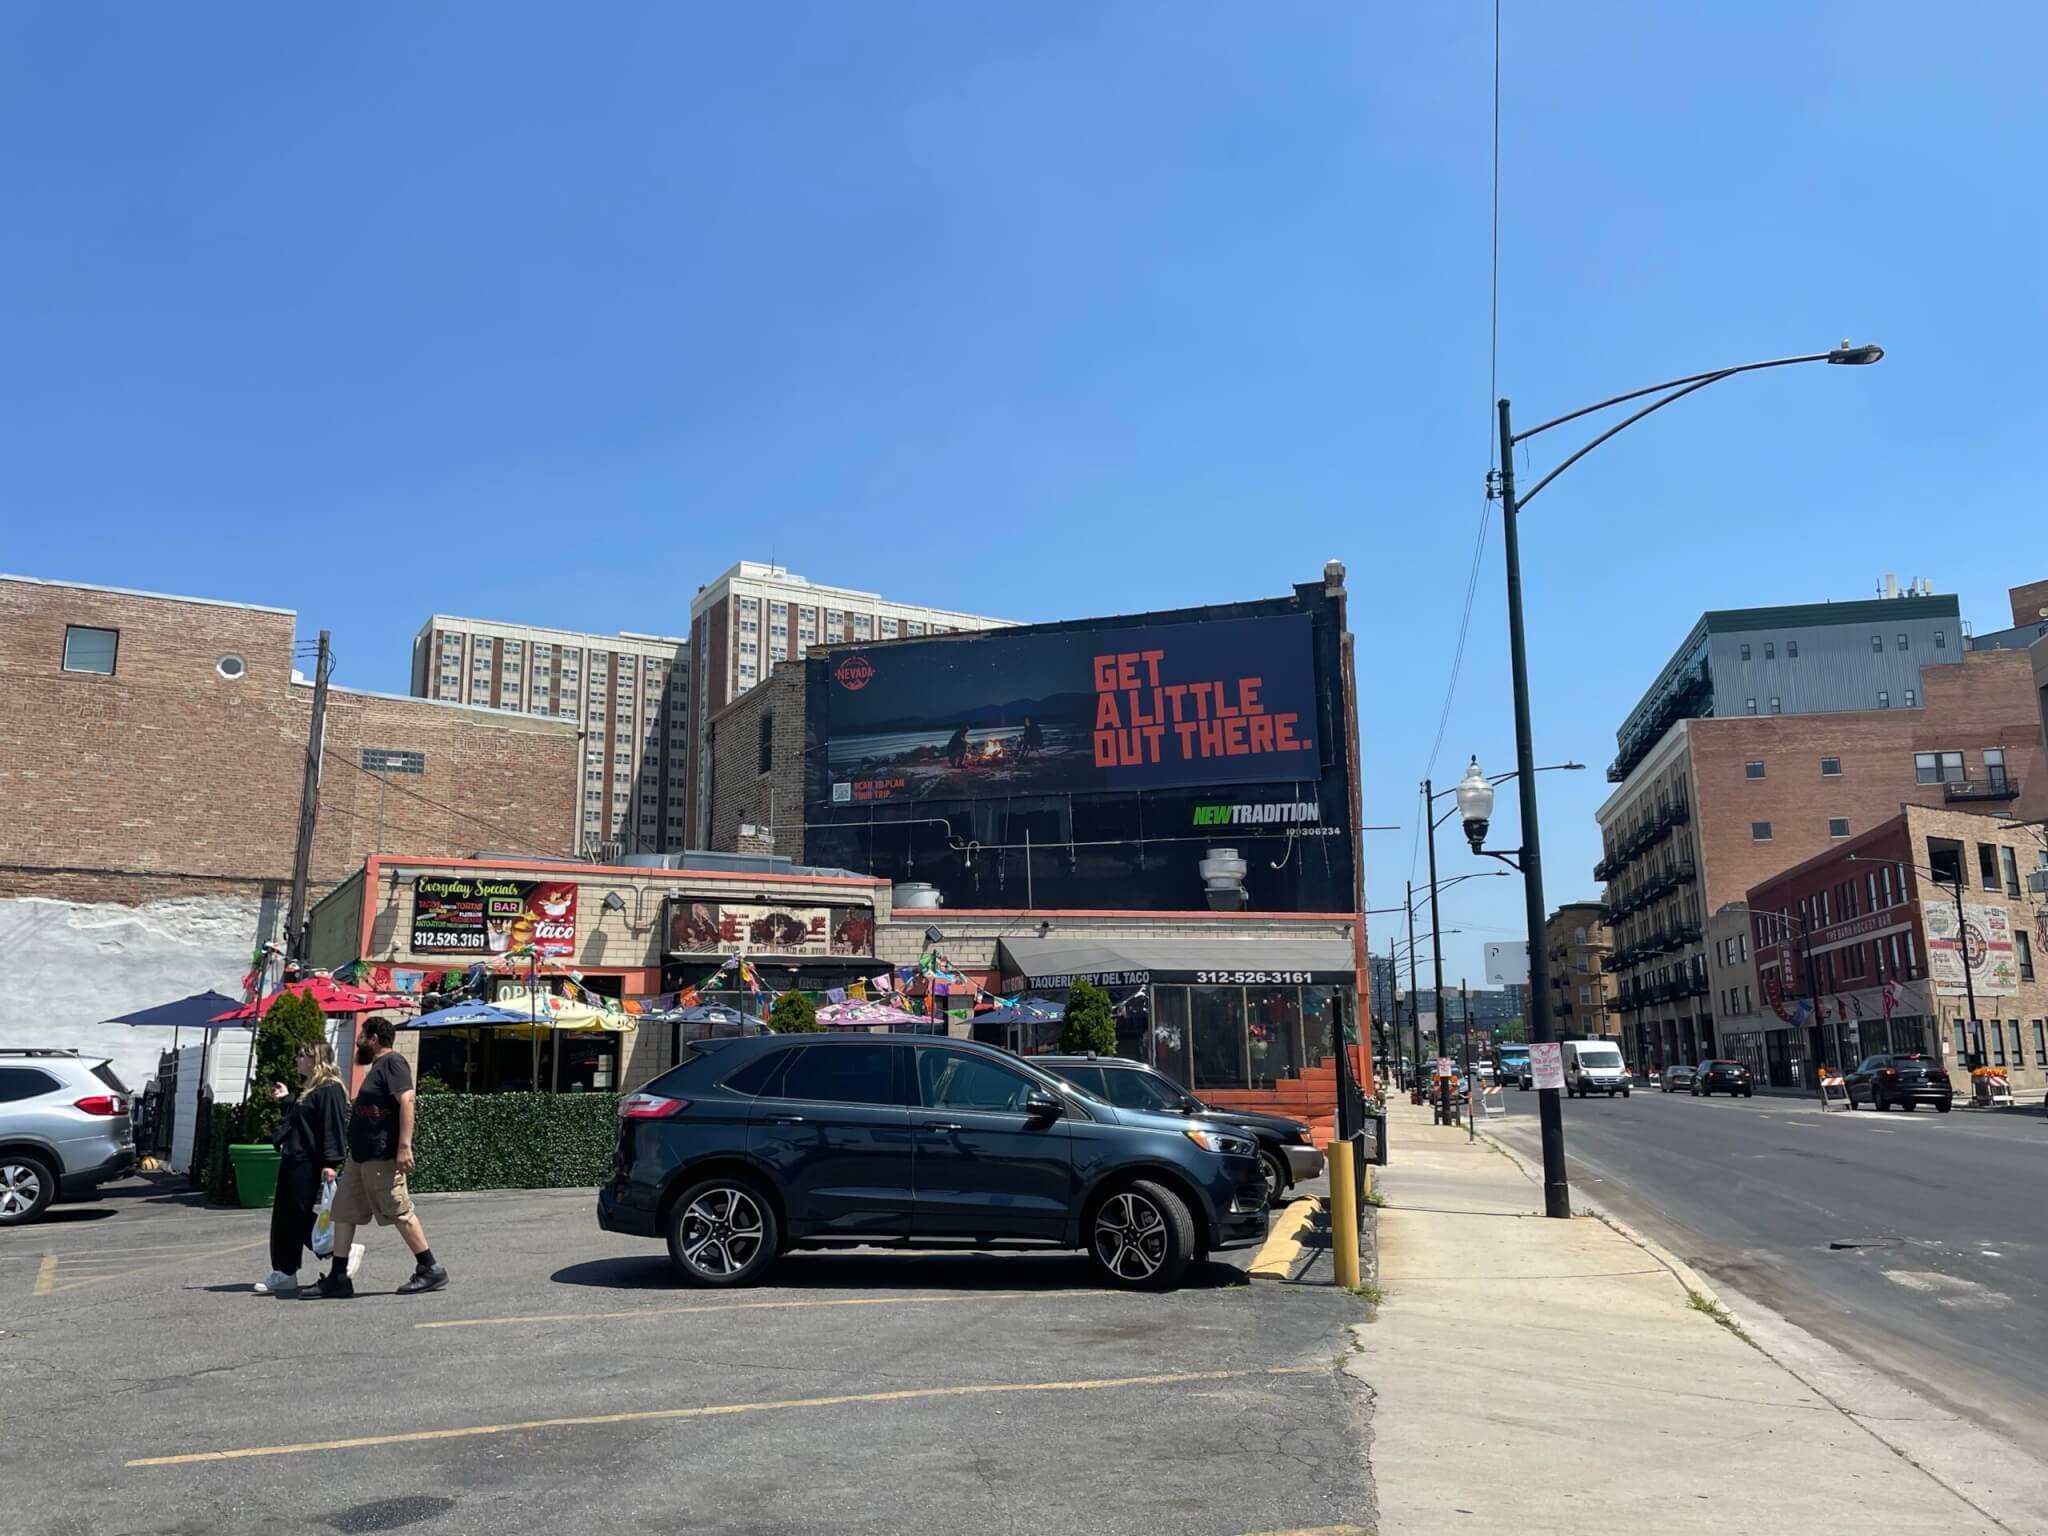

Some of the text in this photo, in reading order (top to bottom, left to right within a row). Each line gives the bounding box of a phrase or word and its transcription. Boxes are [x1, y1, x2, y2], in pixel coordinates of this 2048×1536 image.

[837, 666, 873, 681] NEVADA
[1093, 649, 1164, 693] GET
[1096, 677, 1264, 730] A LITTLE
[1093, 713, 1313, 768] OUT THERE.
[885, 778, 905, 788] PLAN
[418, 876, 520, 898] Everyday Specials
[494, 902, 518, 912] BAR
[533, 920, 574, 939] taco
[414, 931, 485, 947] 312.526.3161
[1783, 950, 1793, 982] BARN
[1103, 973, 1121, 985] DEL
[1123, 971, 1150, 984] TACO
[1196, 971, 1313, 983] 312-526-3161
